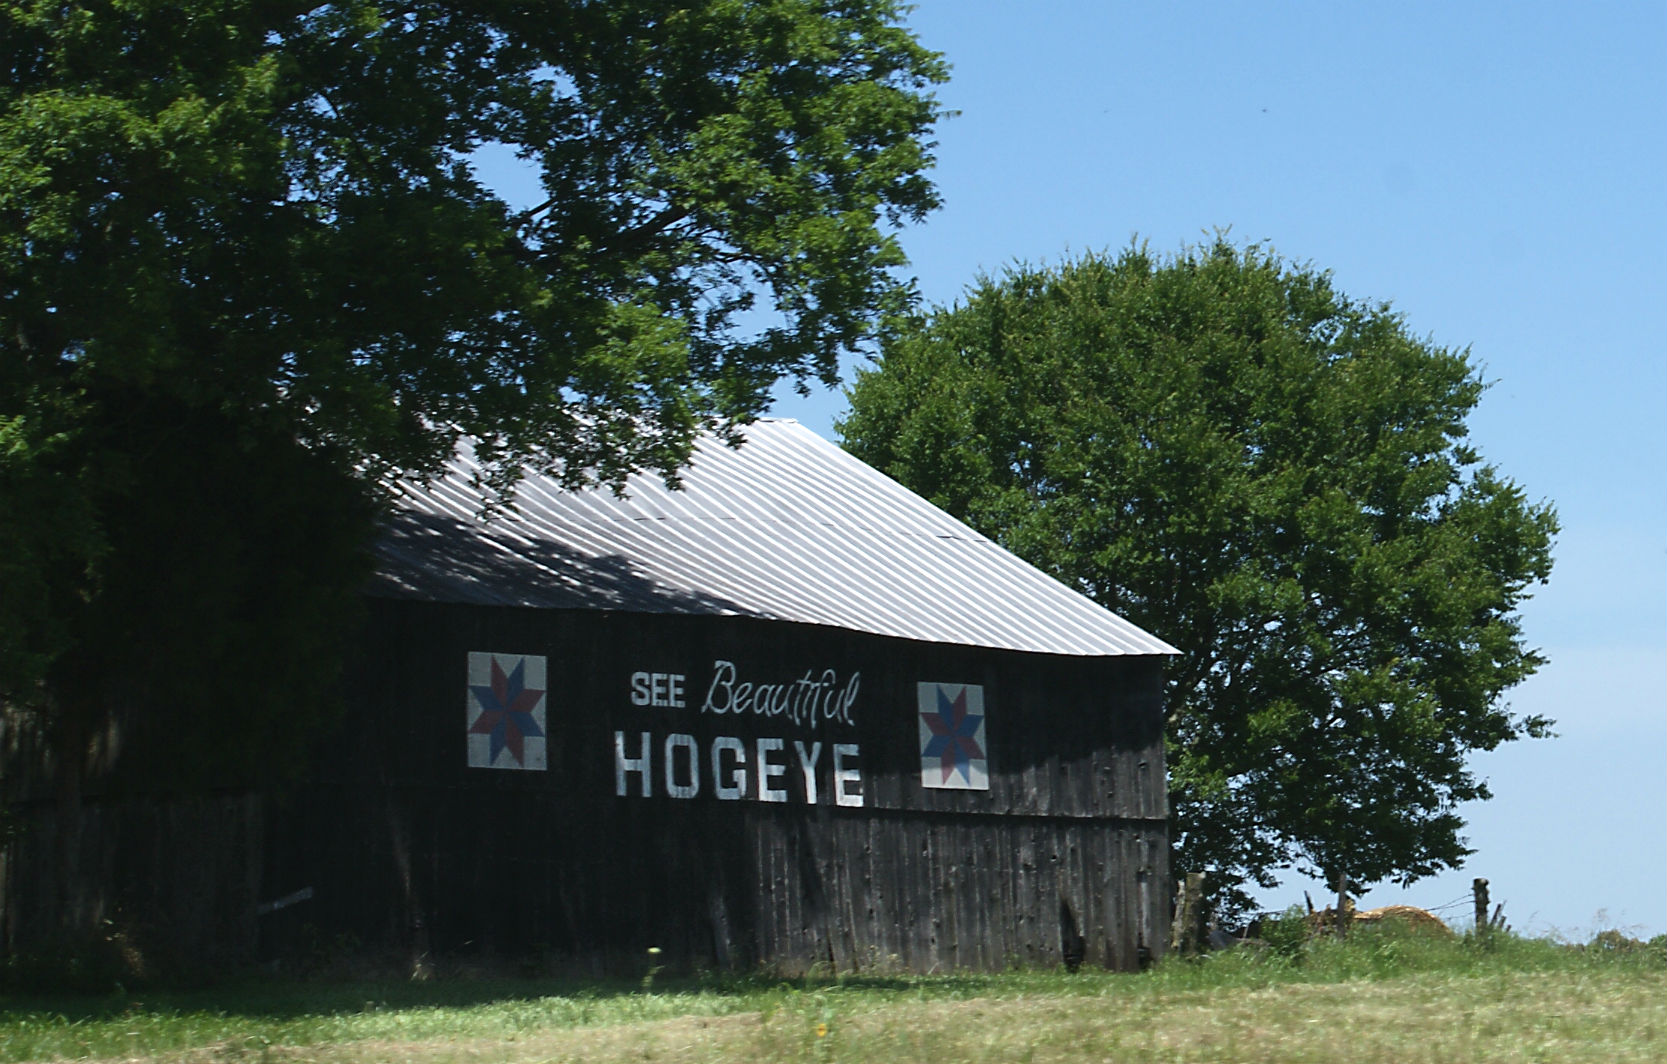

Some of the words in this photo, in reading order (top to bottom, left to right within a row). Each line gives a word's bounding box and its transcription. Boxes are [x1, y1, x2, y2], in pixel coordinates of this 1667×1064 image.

[631, 671, 686, 708] SEE
[701, 660, 860, 730] Beautiful
[614, 730, 865, 808] HOGEYE
